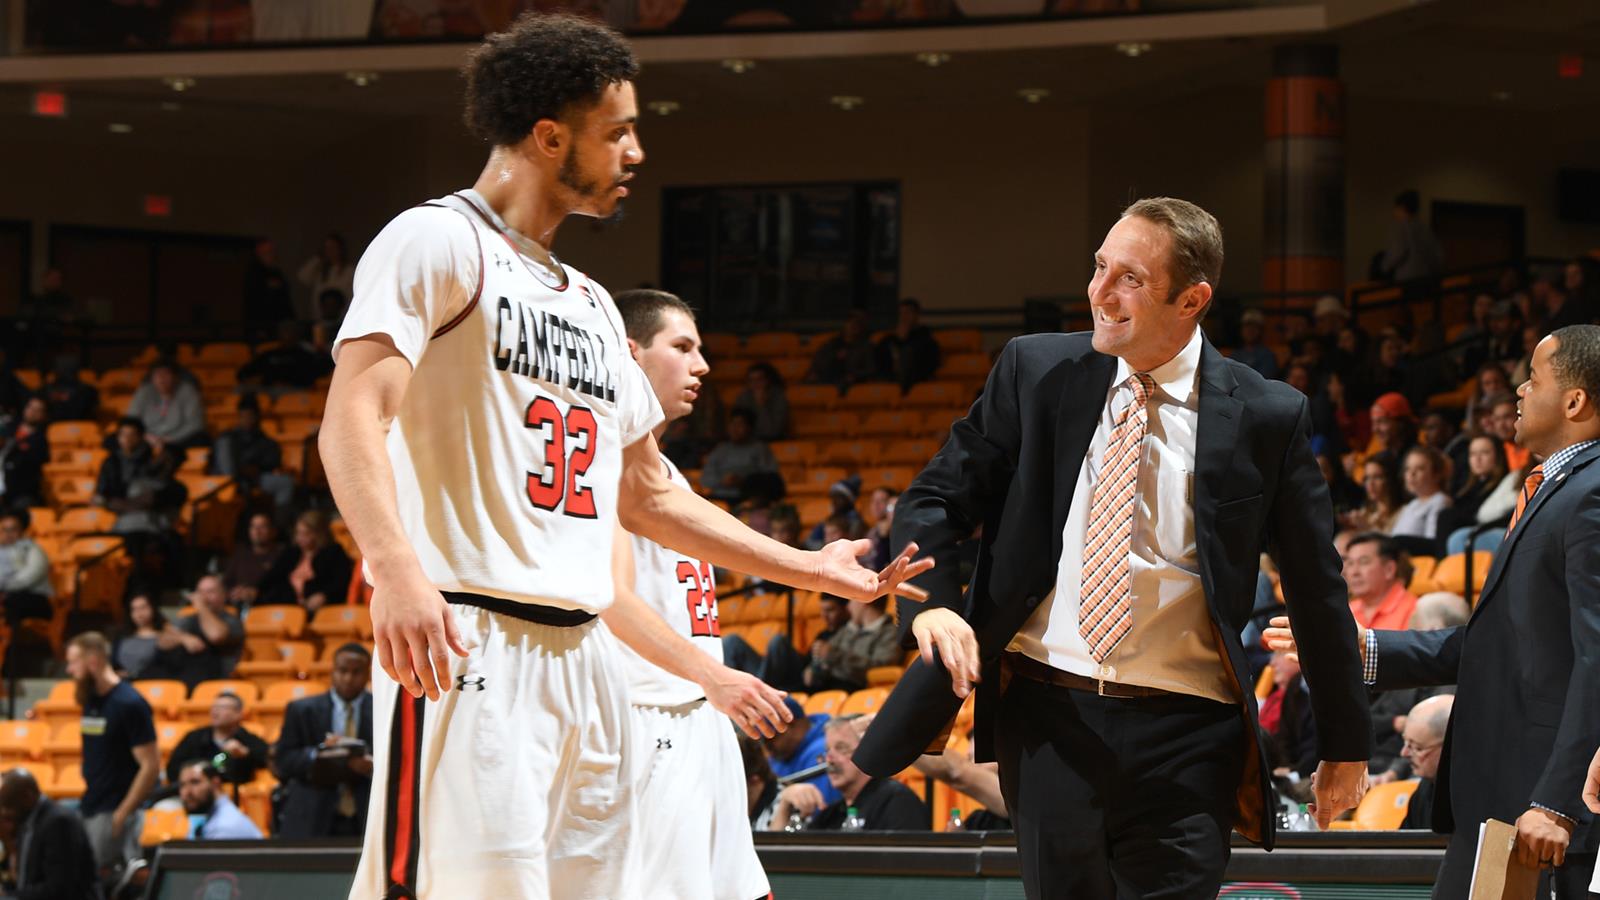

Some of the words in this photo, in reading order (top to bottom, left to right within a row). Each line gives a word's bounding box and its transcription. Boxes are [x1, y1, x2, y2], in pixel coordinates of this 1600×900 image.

[494, 295, 616, 403] CAMPBELL
[524, 395, 599, 519] 32
[675, 560, 721, 637] 22
